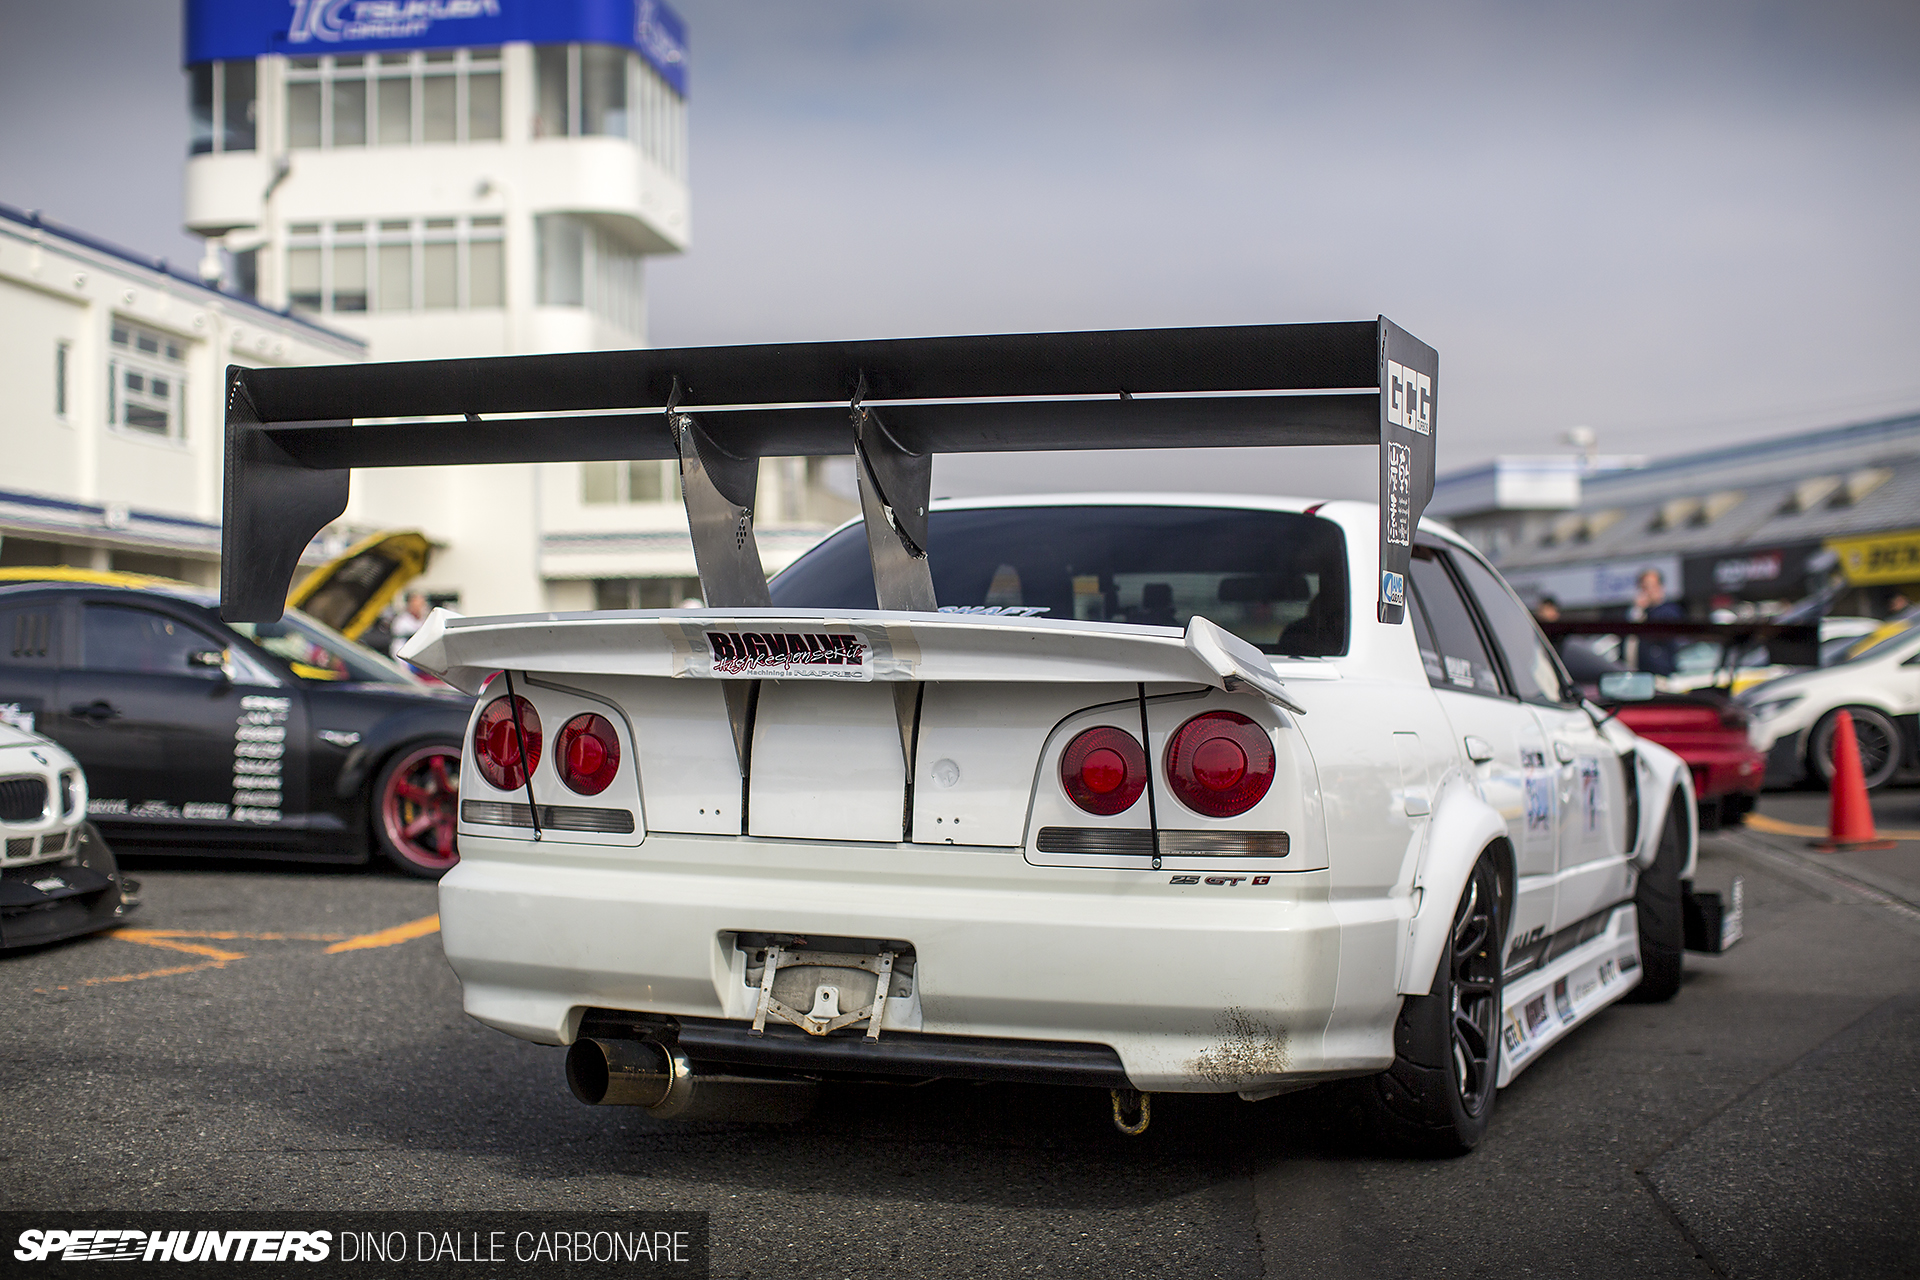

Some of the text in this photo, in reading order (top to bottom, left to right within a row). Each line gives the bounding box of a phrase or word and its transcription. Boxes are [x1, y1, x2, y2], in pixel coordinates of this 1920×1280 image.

[1388, 359, 1431, 436] GCG
[794, 670, 863, 678] NAPREC
[1169, 875, 1201, 885] 25
[1204, 876, 1247, 887] GT
